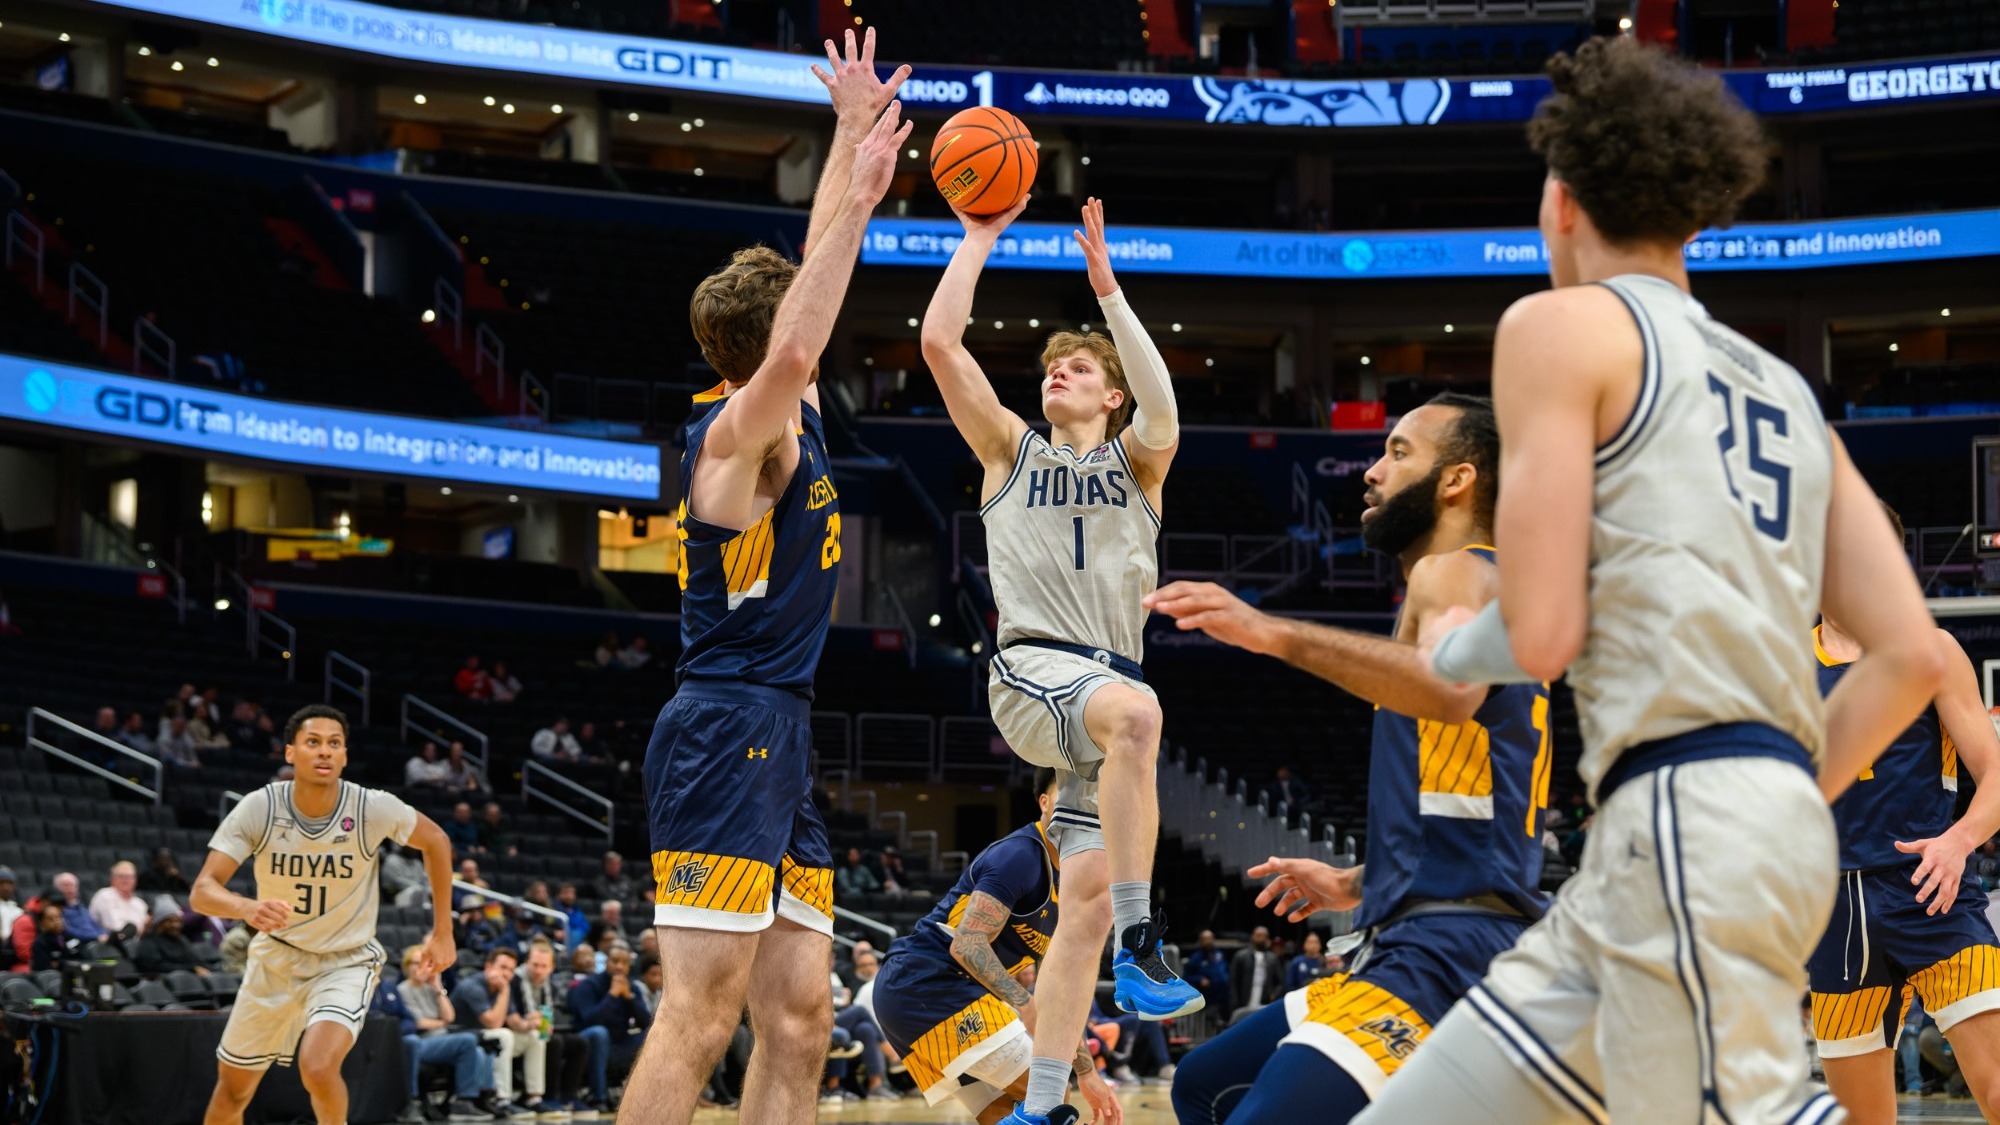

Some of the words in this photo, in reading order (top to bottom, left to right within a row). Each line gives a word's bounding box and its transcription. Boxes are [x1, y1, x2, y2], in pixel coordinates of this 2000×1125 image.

[617, 48, 730, 79] GDIT
[897, 79, 968, 103] ERIOD
[972, 71, 994, 107] 1
[1056, 83, 1128, 106] Invesco
[1128, 87, 1170, 108] QQQ
[1789, 85, 1804, 104] 6
[873, 231, 898, 252] to
[1021, 235, 1060, 258] and
[1484, 242, 1538, 262] From
[1785, 232, 1823, 257] and
[1827, 226, 1942, 251] innovation
[95, 385, 222, 434] GDIT
[236, 410, 329, 449] ideation
[332, 425, 360, 451] to
[543, 449, 661, 483] innovation
[1026, 465, 1128, 509] HOYAS
[1072, 515, 1085, 571] 1
[271, 852, 354, 879] HOYAS
[667, 861, 709, 895] MC
[293, 883, 327, 916] 31
